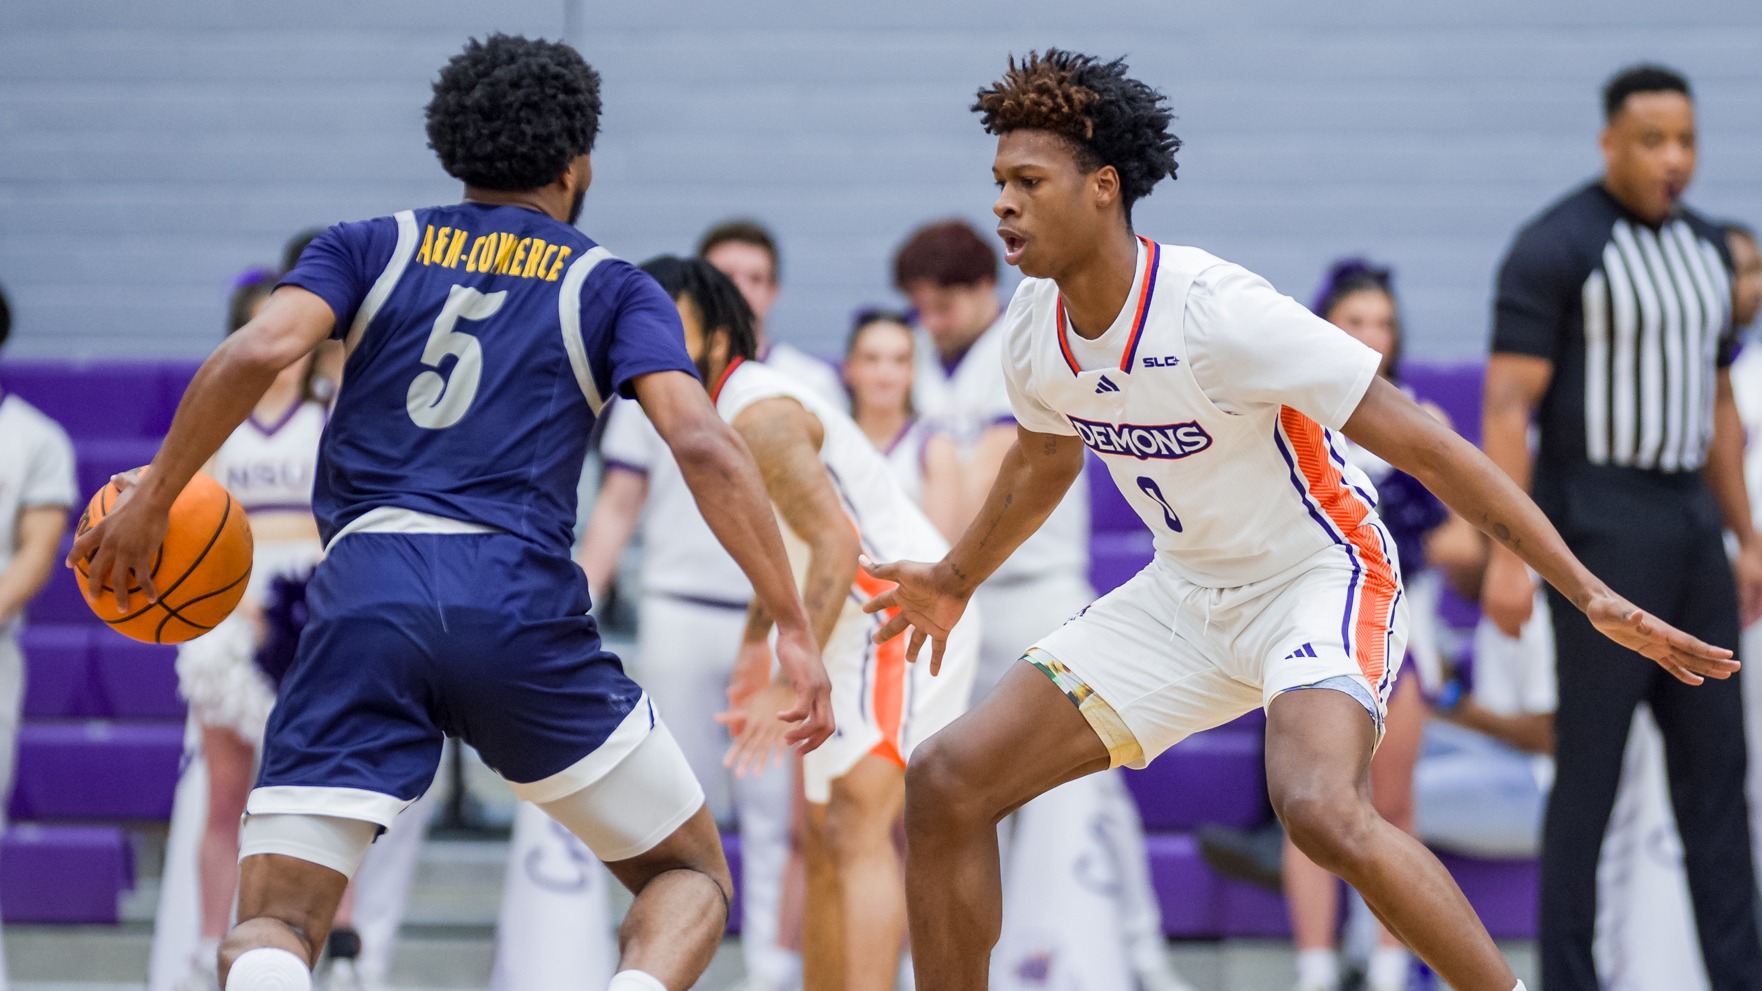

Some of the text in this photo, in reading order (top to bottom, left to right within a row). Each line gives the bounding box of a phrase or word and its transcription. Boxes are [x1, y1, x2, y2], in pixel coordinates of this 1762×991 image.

[406, 284, 508, 429] 5
[1142, 356, 1177, 367] SLC
[1073, 420, 1208, 456] DEMONS
[1136, 476, 1183, 533] 0
